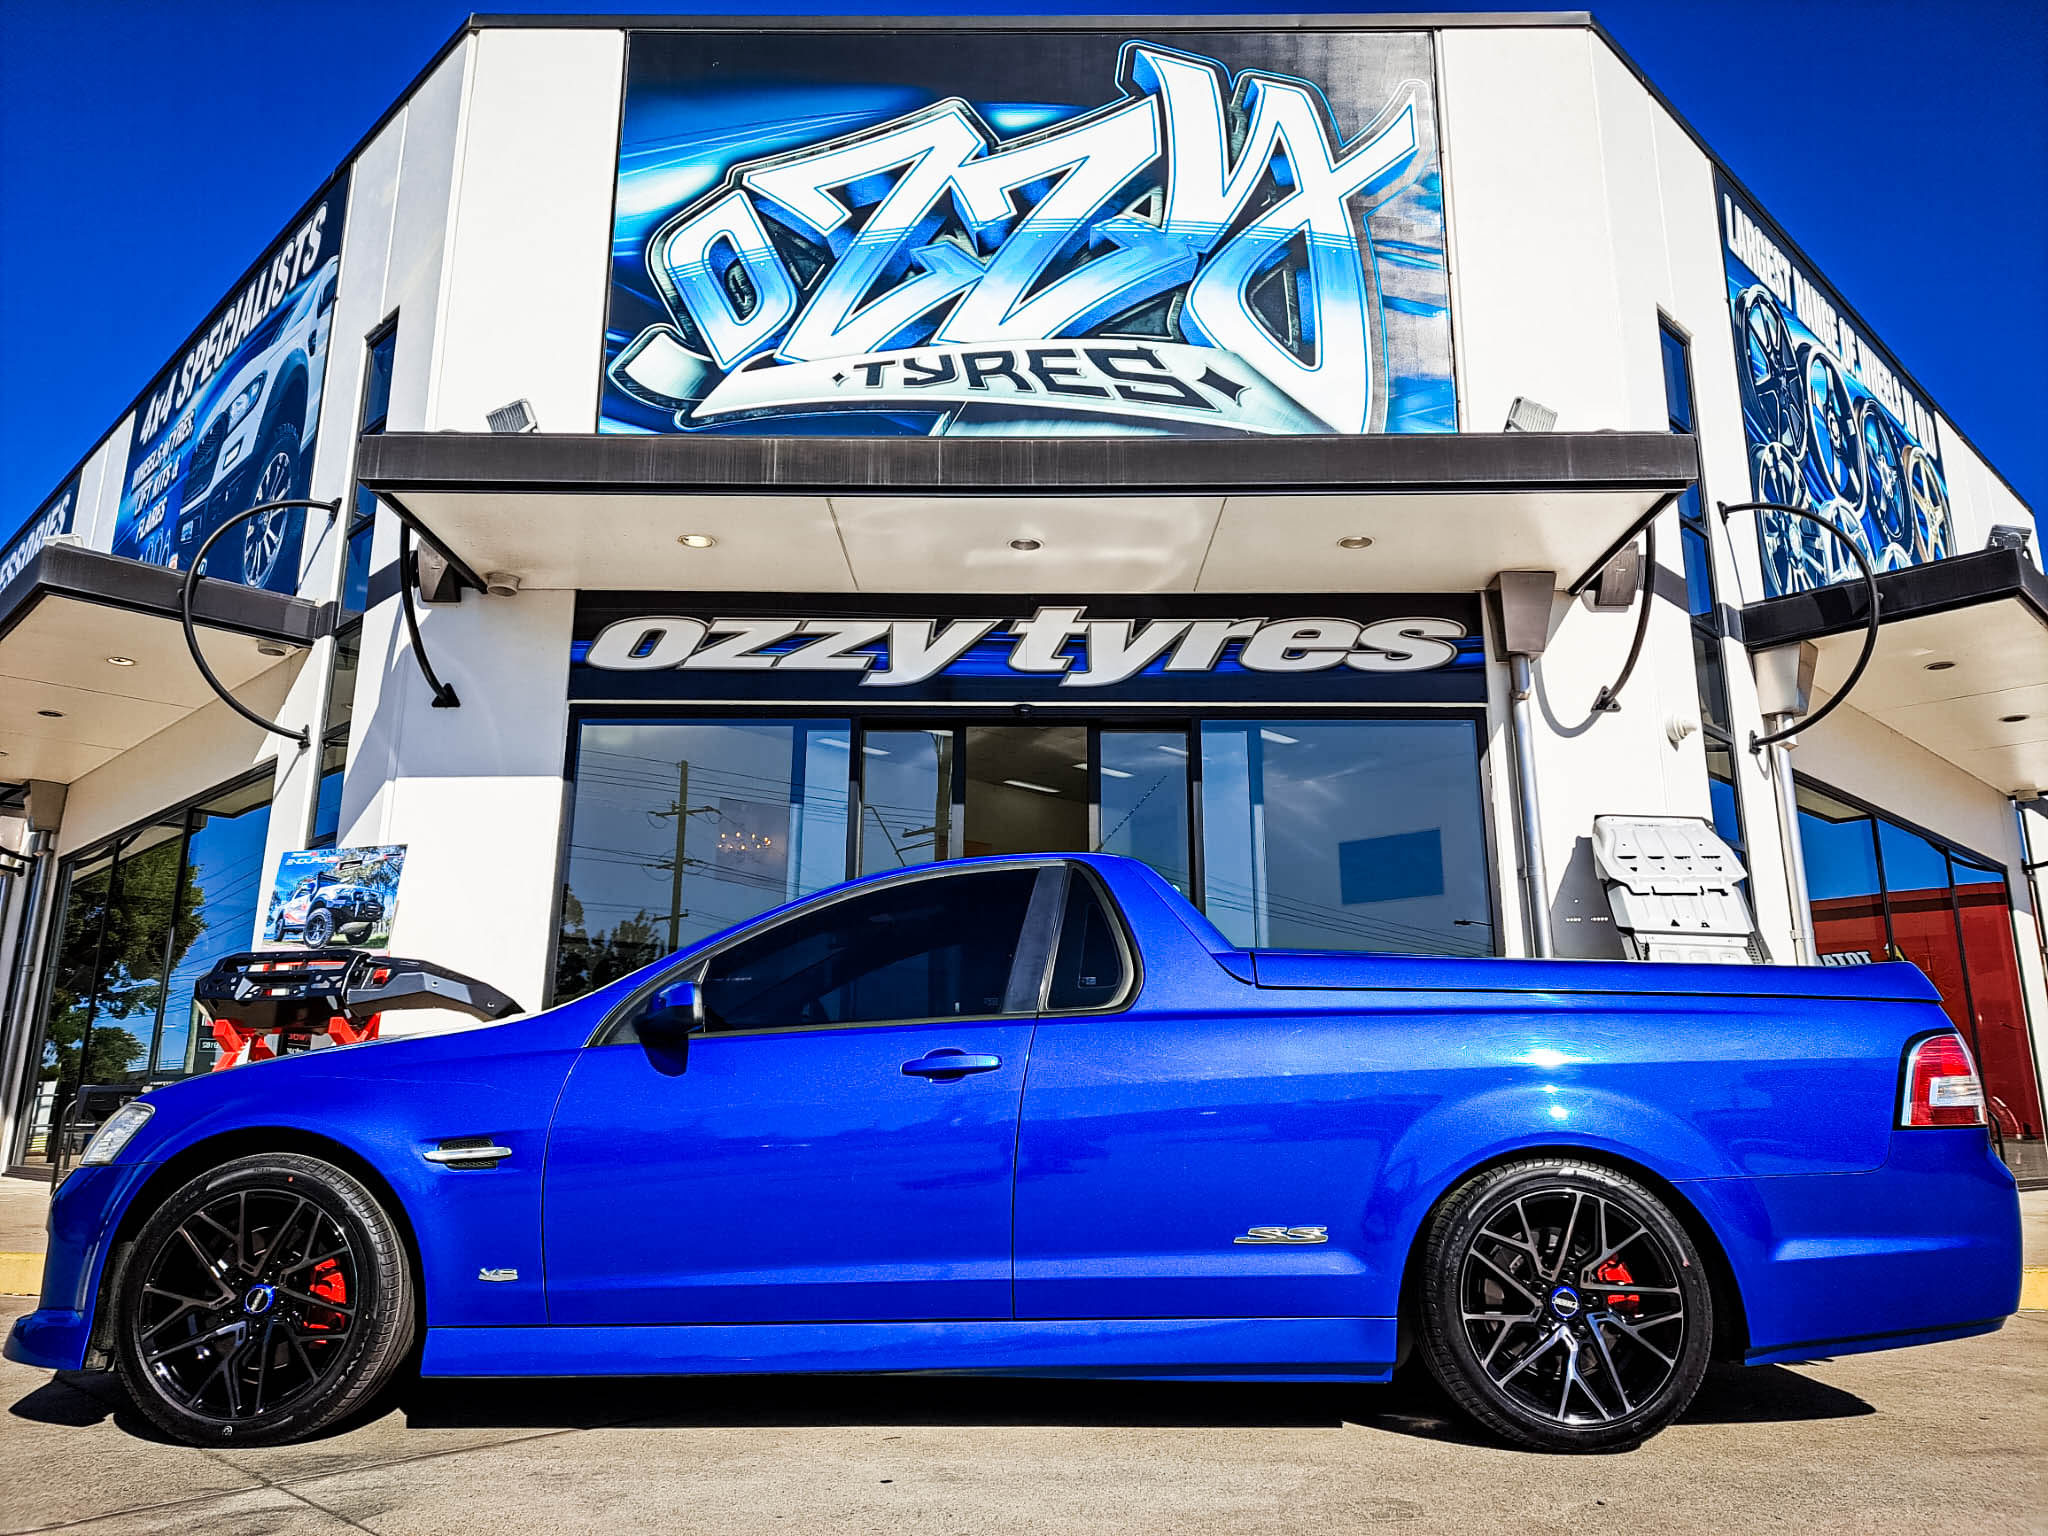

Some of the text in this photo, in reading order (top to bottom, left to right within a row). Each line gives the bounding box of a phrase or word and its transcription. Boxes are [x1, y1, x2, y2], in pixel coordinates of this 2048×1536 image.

[175, 201, 328, 410] SPECIALISTS
[660, 40, 1432, 432] OZZY
[853, 345, 1221, 413] TYRES
[1724, 192, 1793, 312] LARGEST
[1793, 266, 1842, 362] RANGE
[1838, 317, 1858, 379] OF
[1856, 335, 1905, 426] WHEELS
[585, 605, 1468, 687] ozzy tyres
[1233, 1225, 1329, 1244] SS
